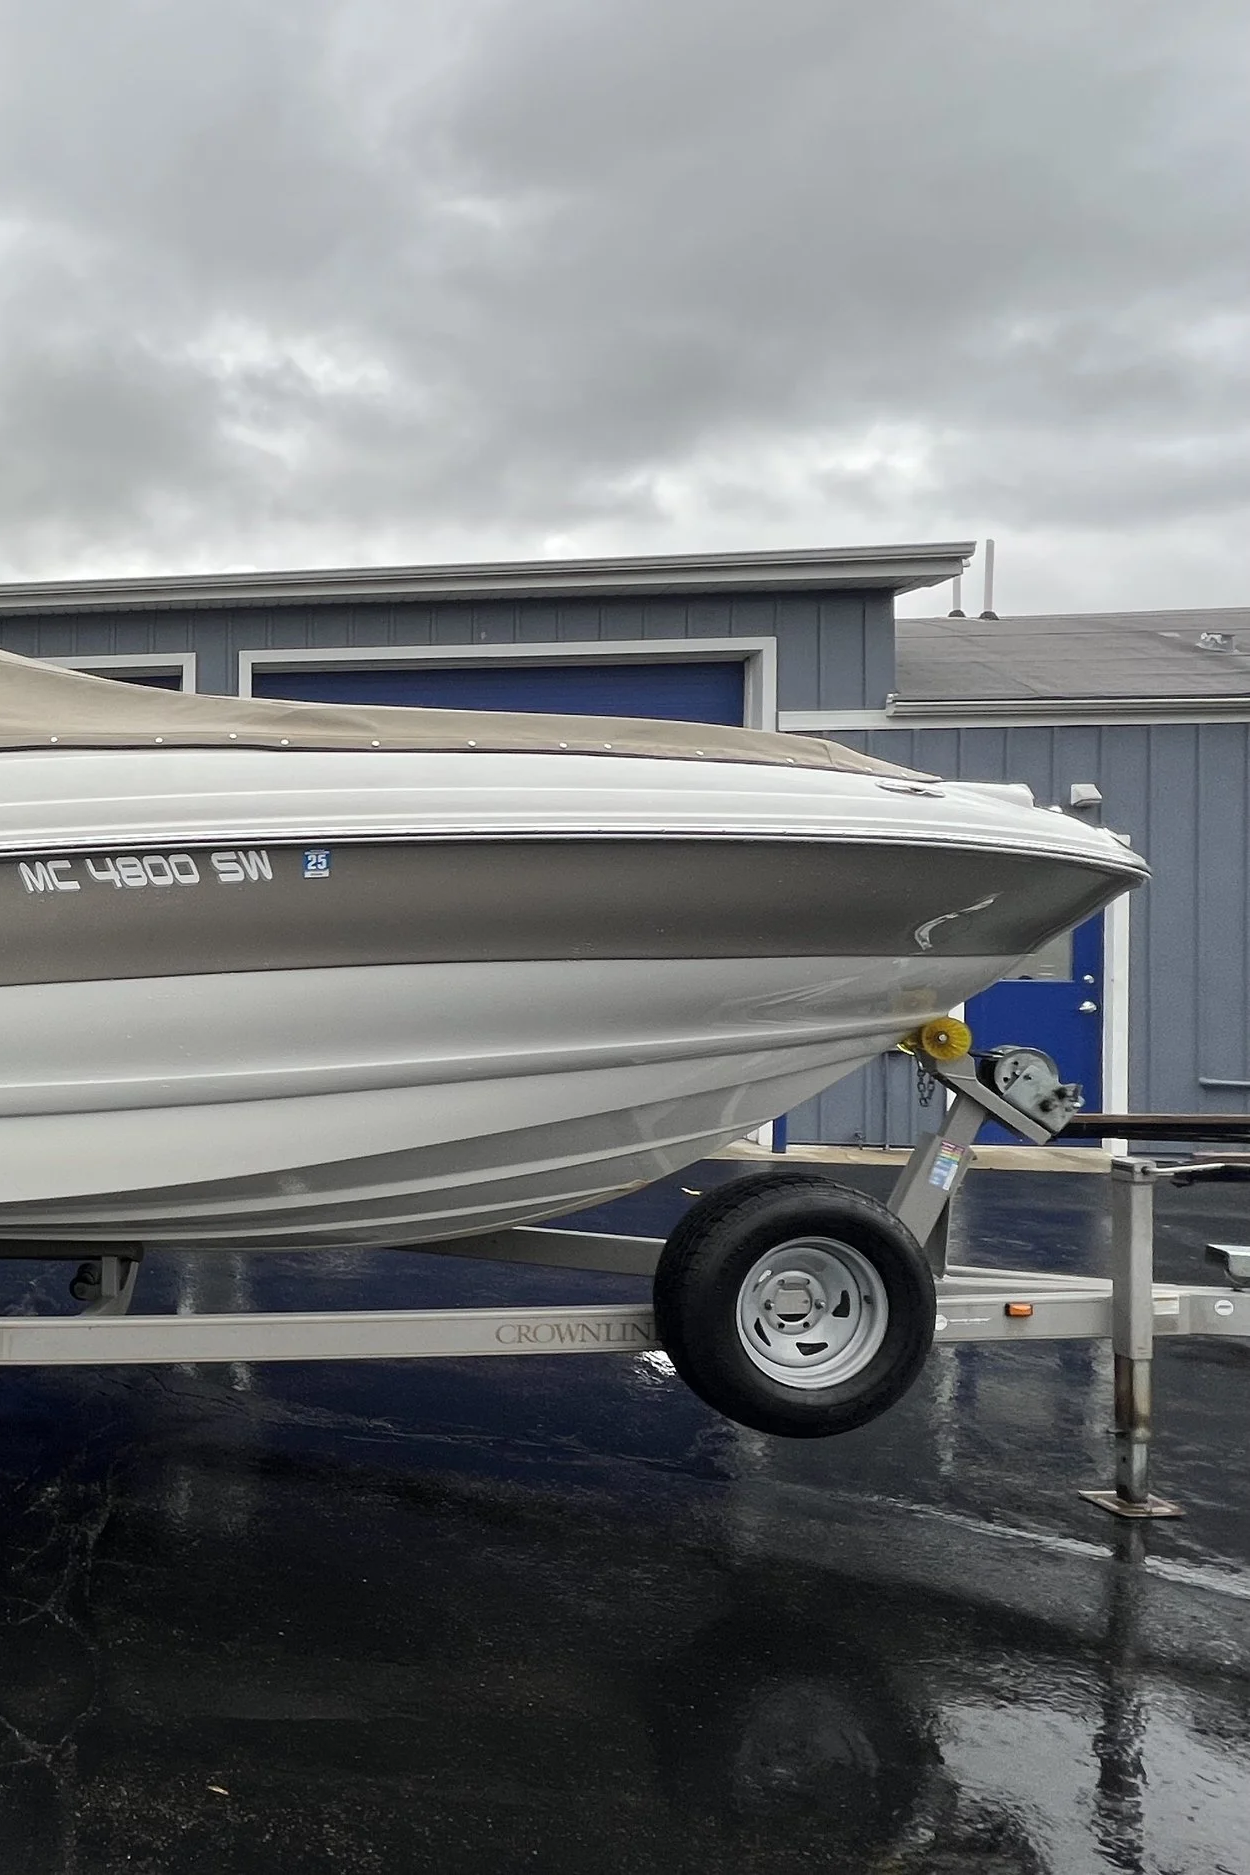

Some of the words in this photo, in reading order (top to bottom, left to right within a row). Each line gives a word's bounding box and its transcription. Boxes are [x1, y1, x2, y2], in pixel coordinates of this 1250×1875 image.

[18, 860, 81, 893] MC
[85, 853, 200, 888] 4800
[211, 850, 274, 883] SW
[307, 854, 327, 870] 25
[495, 1322, 656, 1345] CROWNLIN
